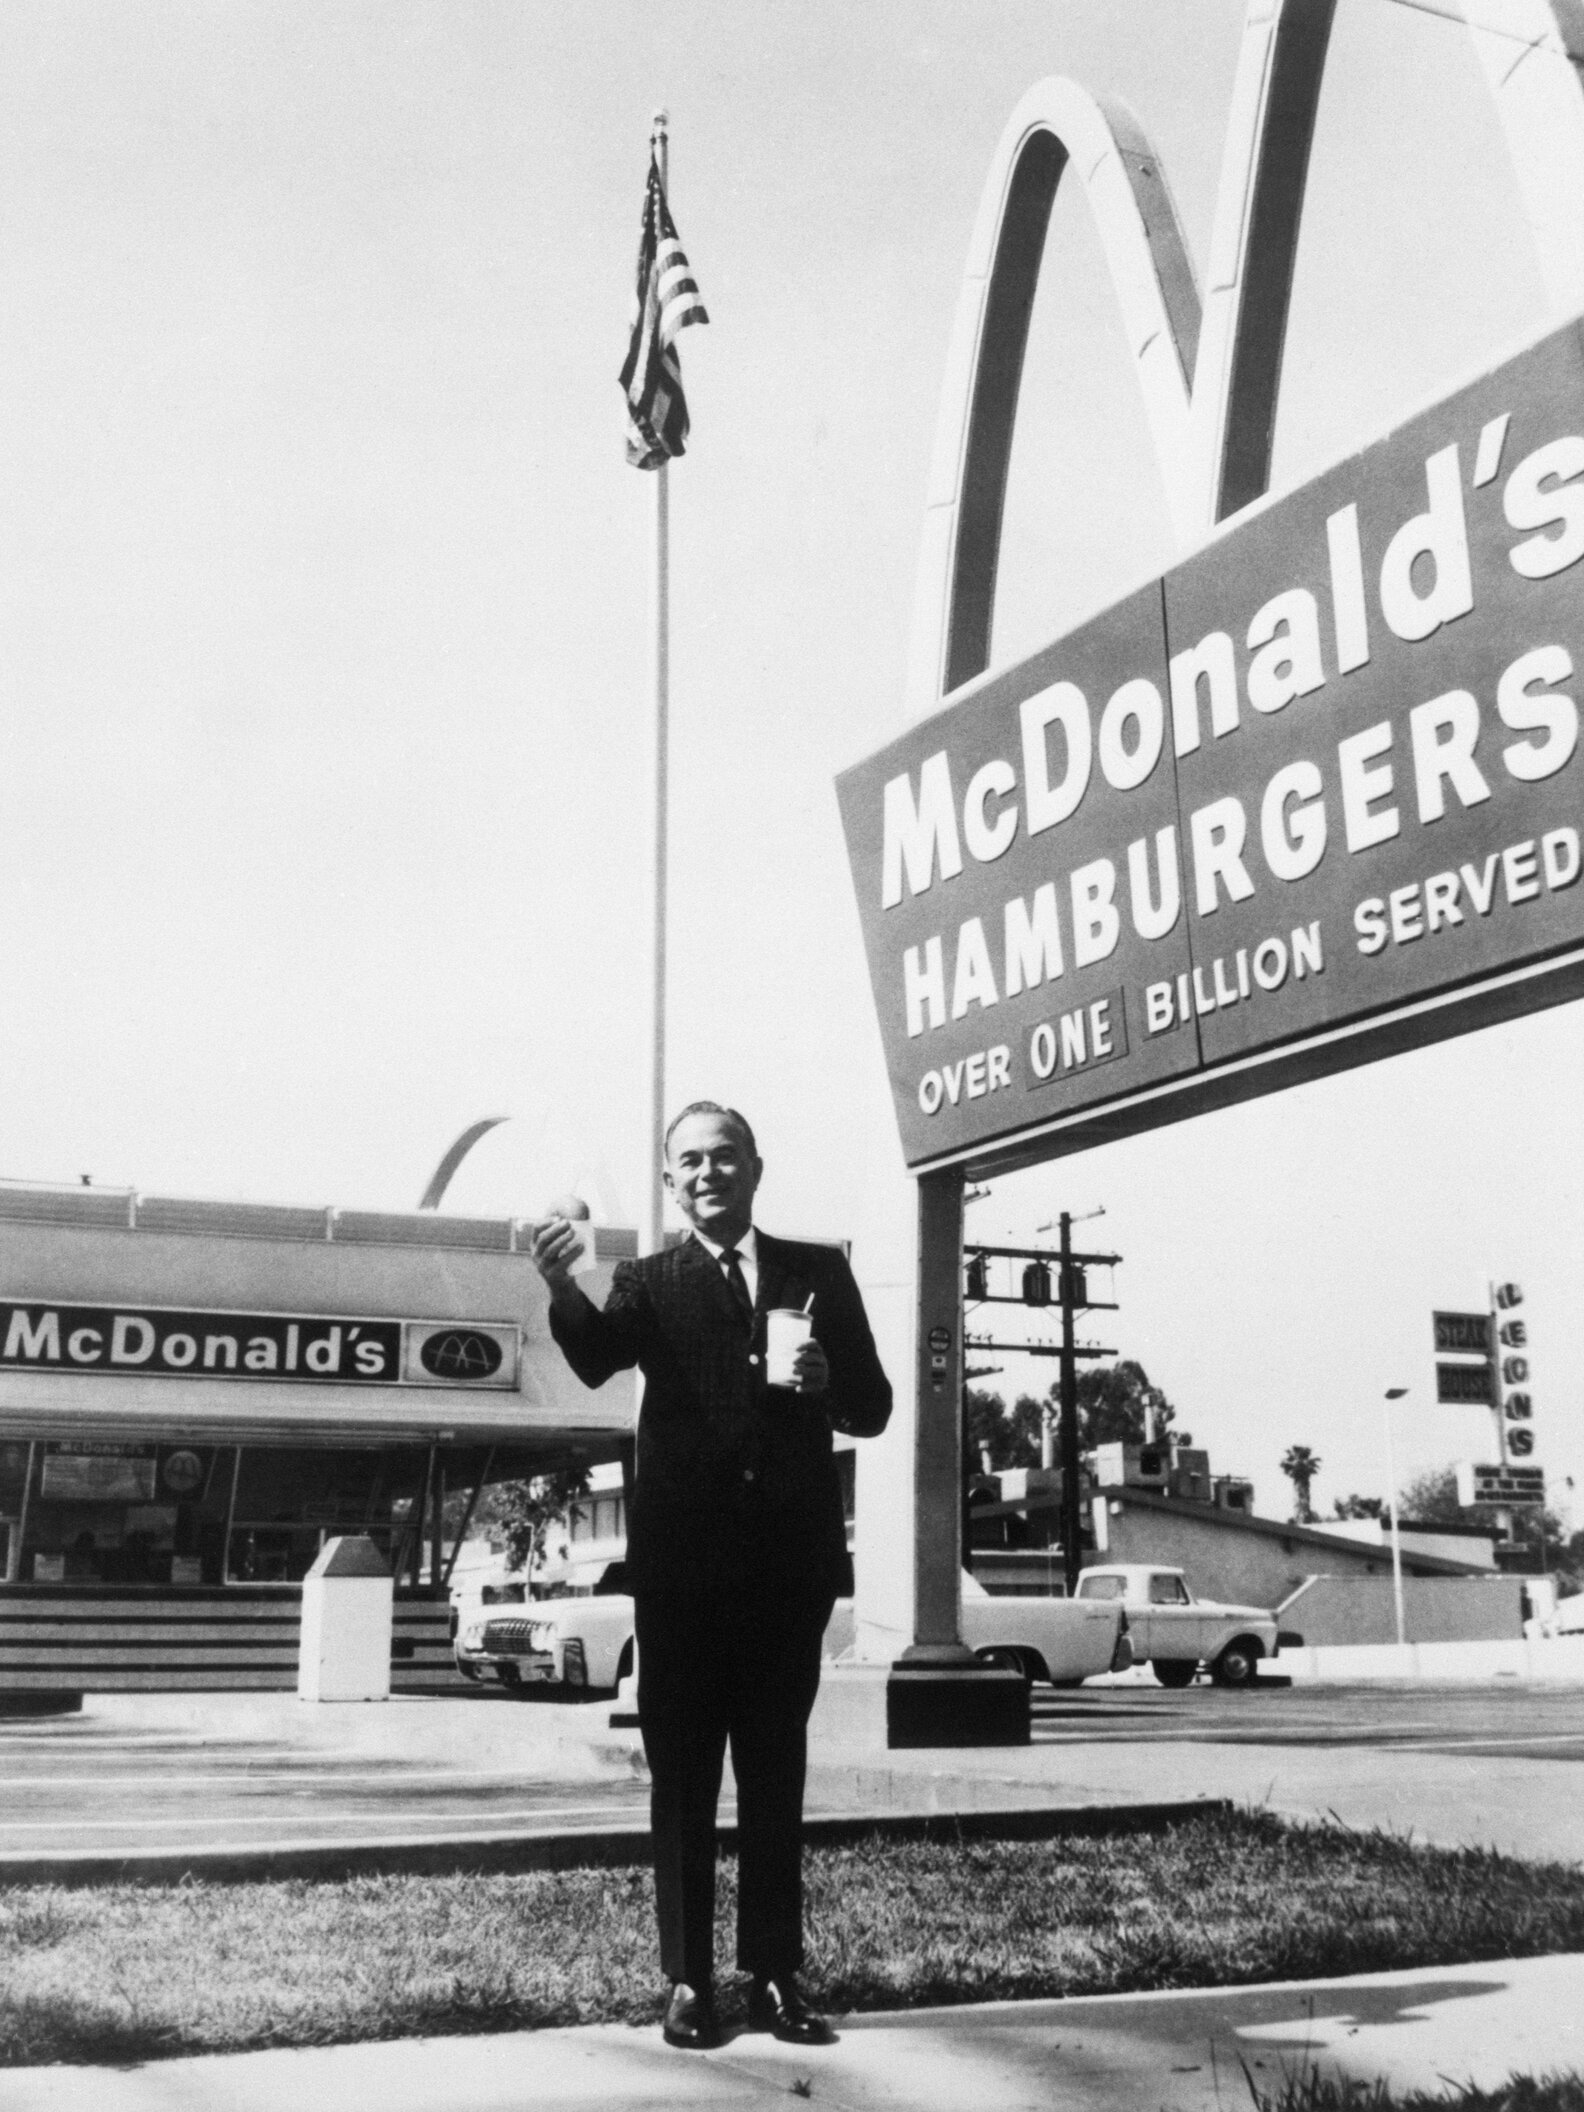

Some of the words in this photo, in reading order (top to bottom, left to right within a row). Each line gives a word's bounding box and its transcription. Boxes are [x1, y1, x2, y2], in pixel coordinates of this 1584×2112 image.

[877, 412, 1584, 911] McDonald's
[902, 645, 1579, 1038] HAMBURGERS
[918, 1044, 1011, 1115] OVER
[1030, 999, 1113, 1078] ONE
[1145, 921, 1323, 1033] BILLION
[1353, 827, 1581, 953] SERVED
[3, 1309, 386, 1374] McDonald's
